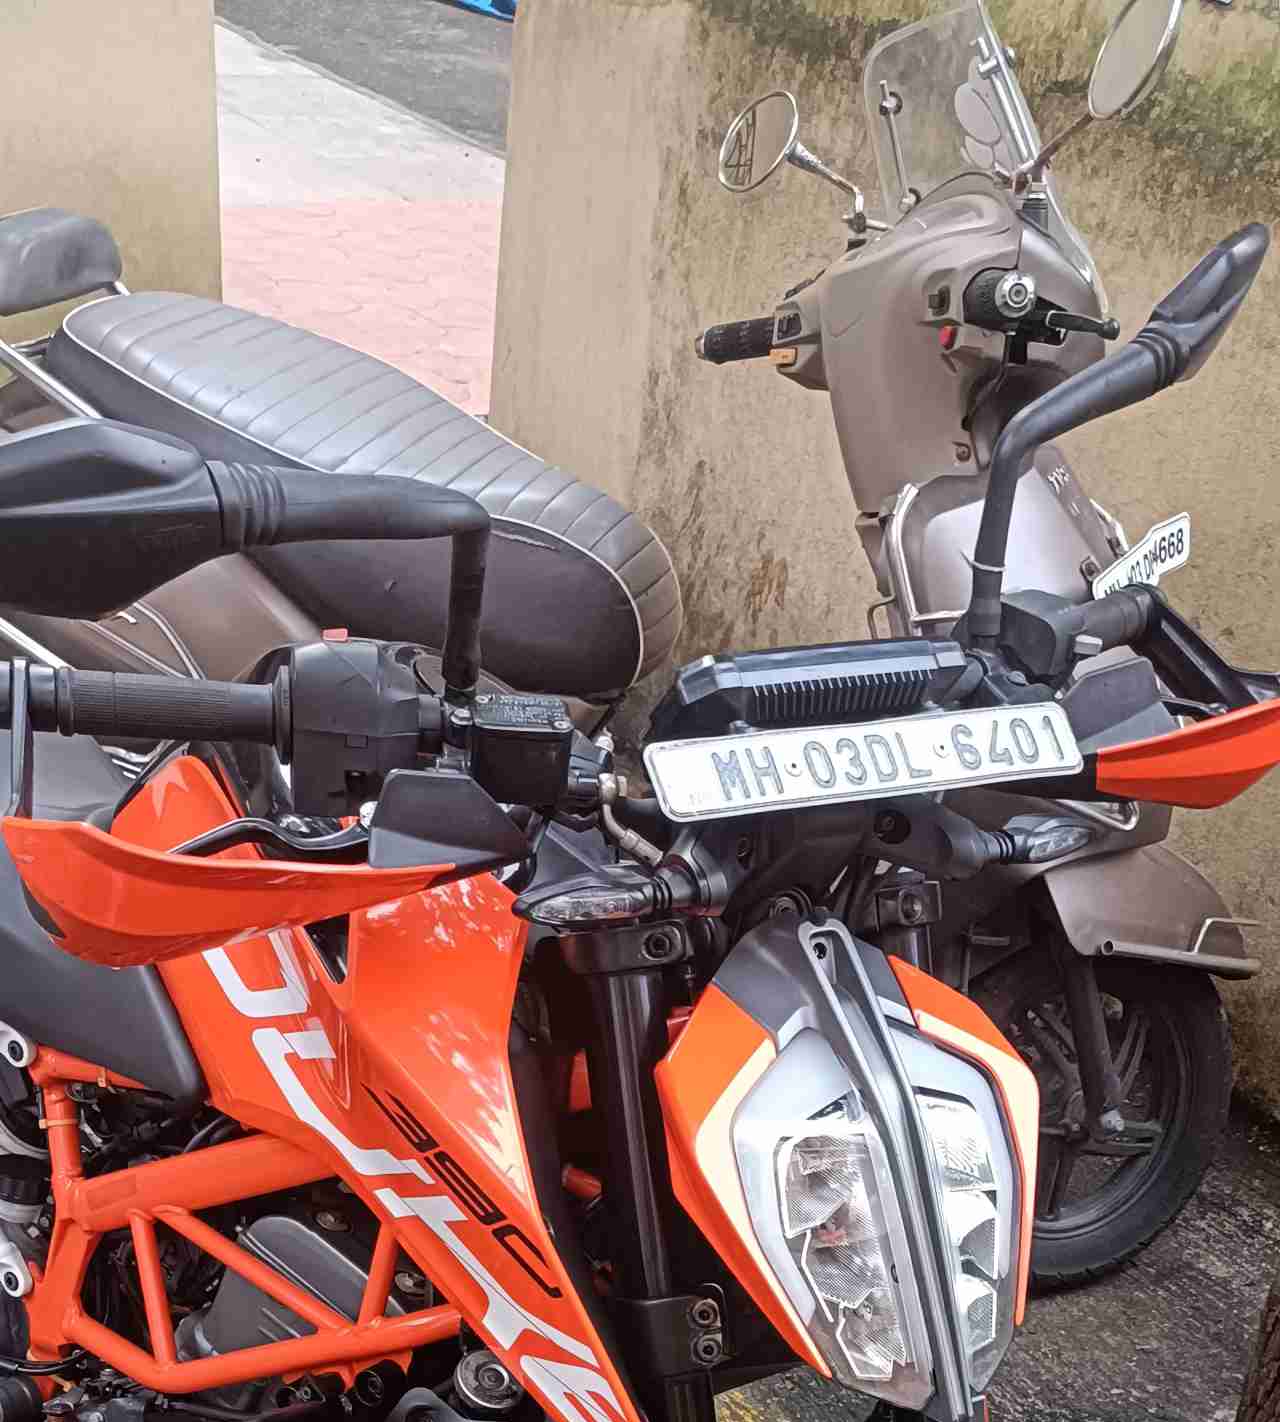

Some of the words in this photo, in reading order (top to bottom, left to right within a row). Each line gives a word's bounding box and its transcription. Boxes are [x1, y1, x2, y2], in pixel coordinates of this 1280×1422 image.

[711, 745, 784, 801] MH
[951, 715, 1065, 770] 6401
[360, 1082, 564, 1298] 390
